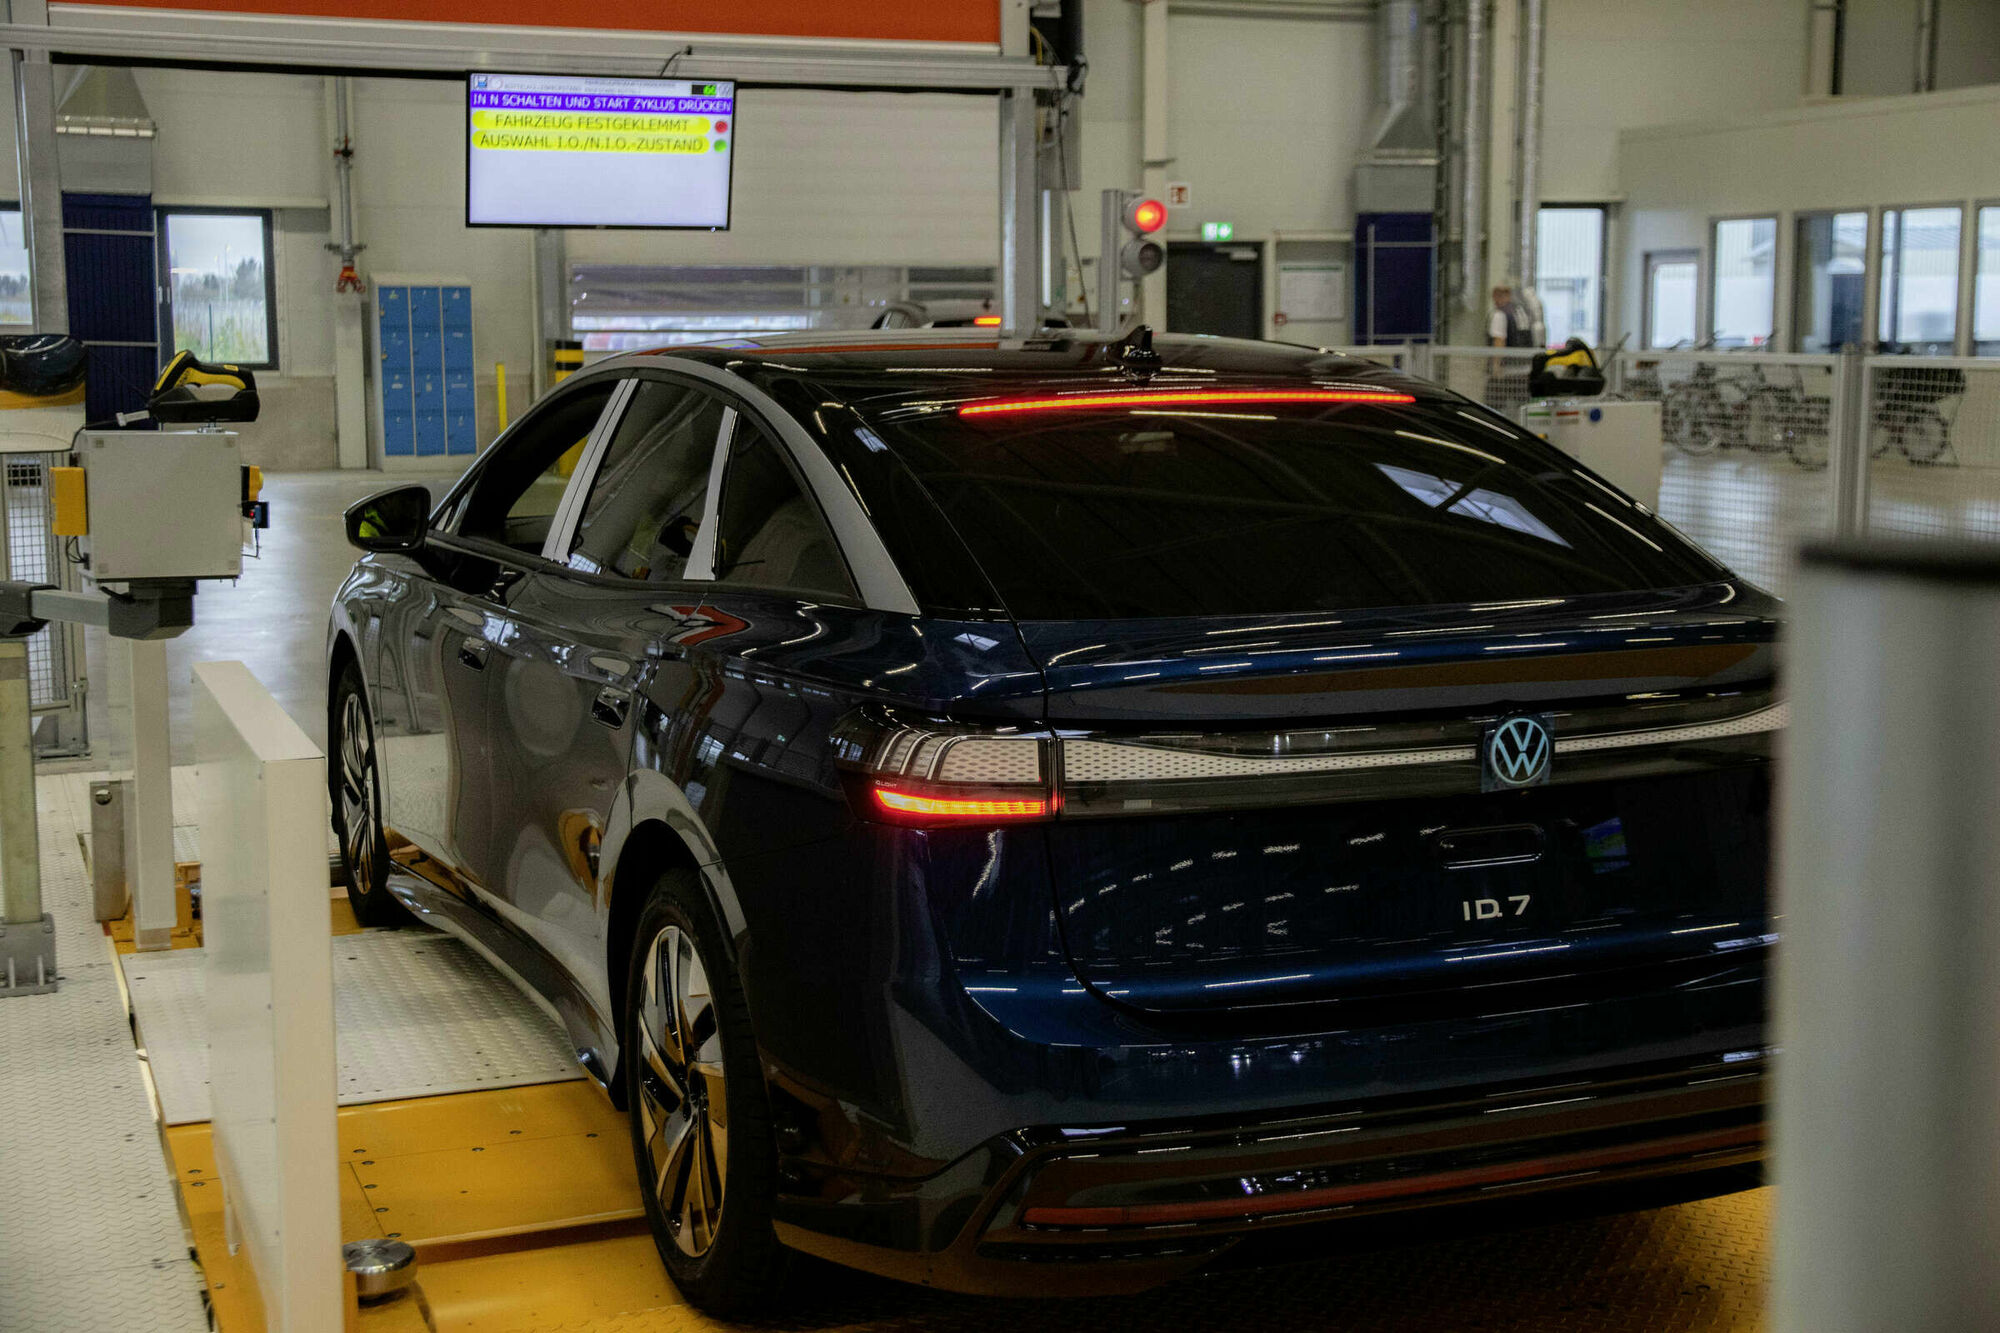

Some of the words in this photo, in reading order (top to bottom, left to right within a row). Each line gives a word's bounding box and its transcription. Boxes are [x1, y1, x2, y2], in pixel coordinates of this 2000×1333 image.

[473, 93, 487, 105] IN
[490, 94, 499, 106] N
[502, 94, 563, 107] SCHALTEN
[565, 97, 590, 109] UND
[593, 97, 630, 110] START
[633, 99, 676, 111] ZYKLUS
[678, 100, 732, 113] DRÜCKEN
[495, 114, 573, 129] FAHRZEUG
[578, 116, 689, 132] FESTGEKLEMMT
[480, 133, 552, 148] AUSWAHL
